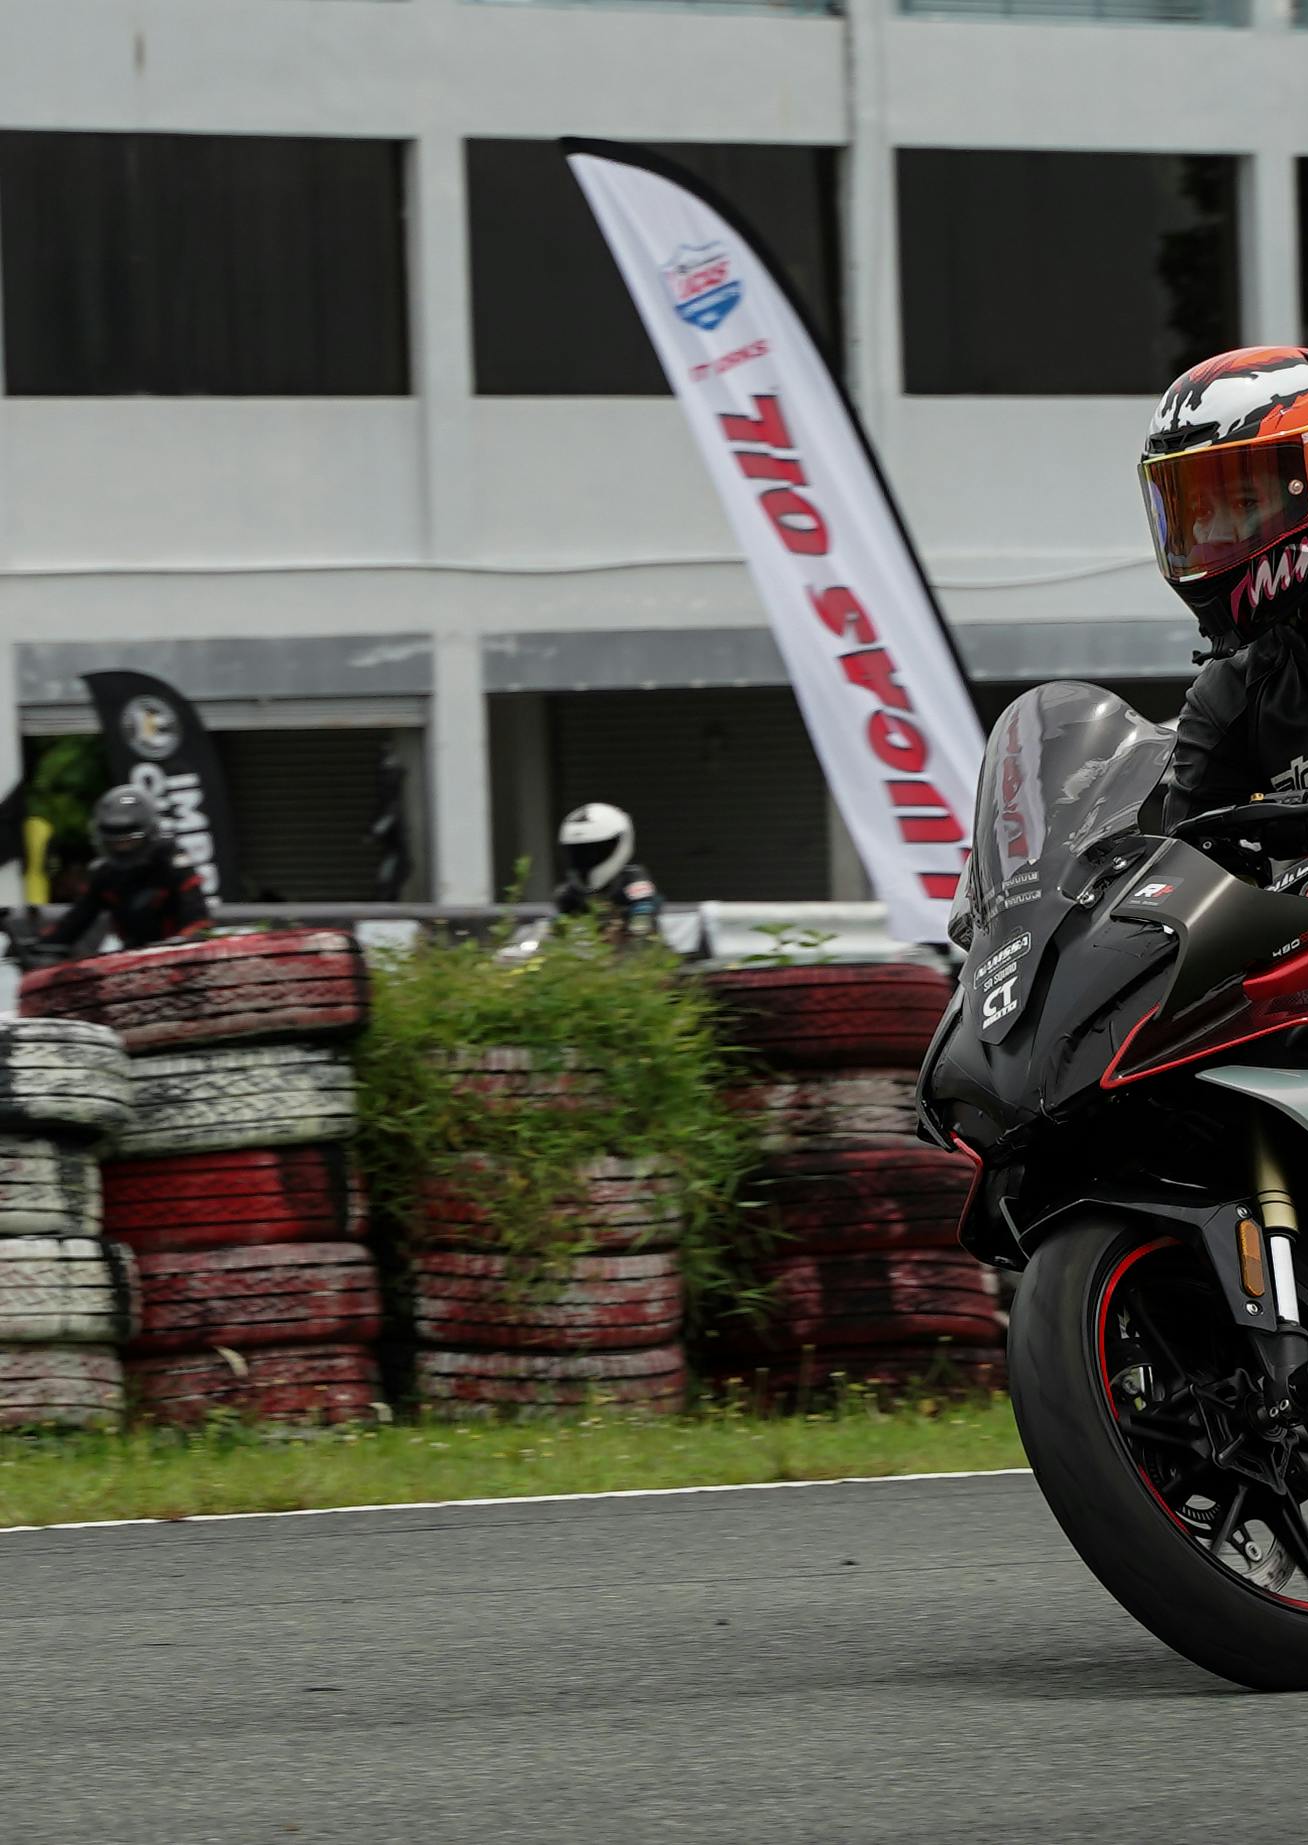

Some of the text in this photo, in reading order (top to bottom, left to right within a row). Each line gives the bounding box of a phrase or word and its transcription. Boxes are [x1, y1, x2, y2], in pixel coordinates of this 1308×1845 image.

[718, 394, 973, 899] LUCAS OIL
[983, 976, 1018, 1017] CT
